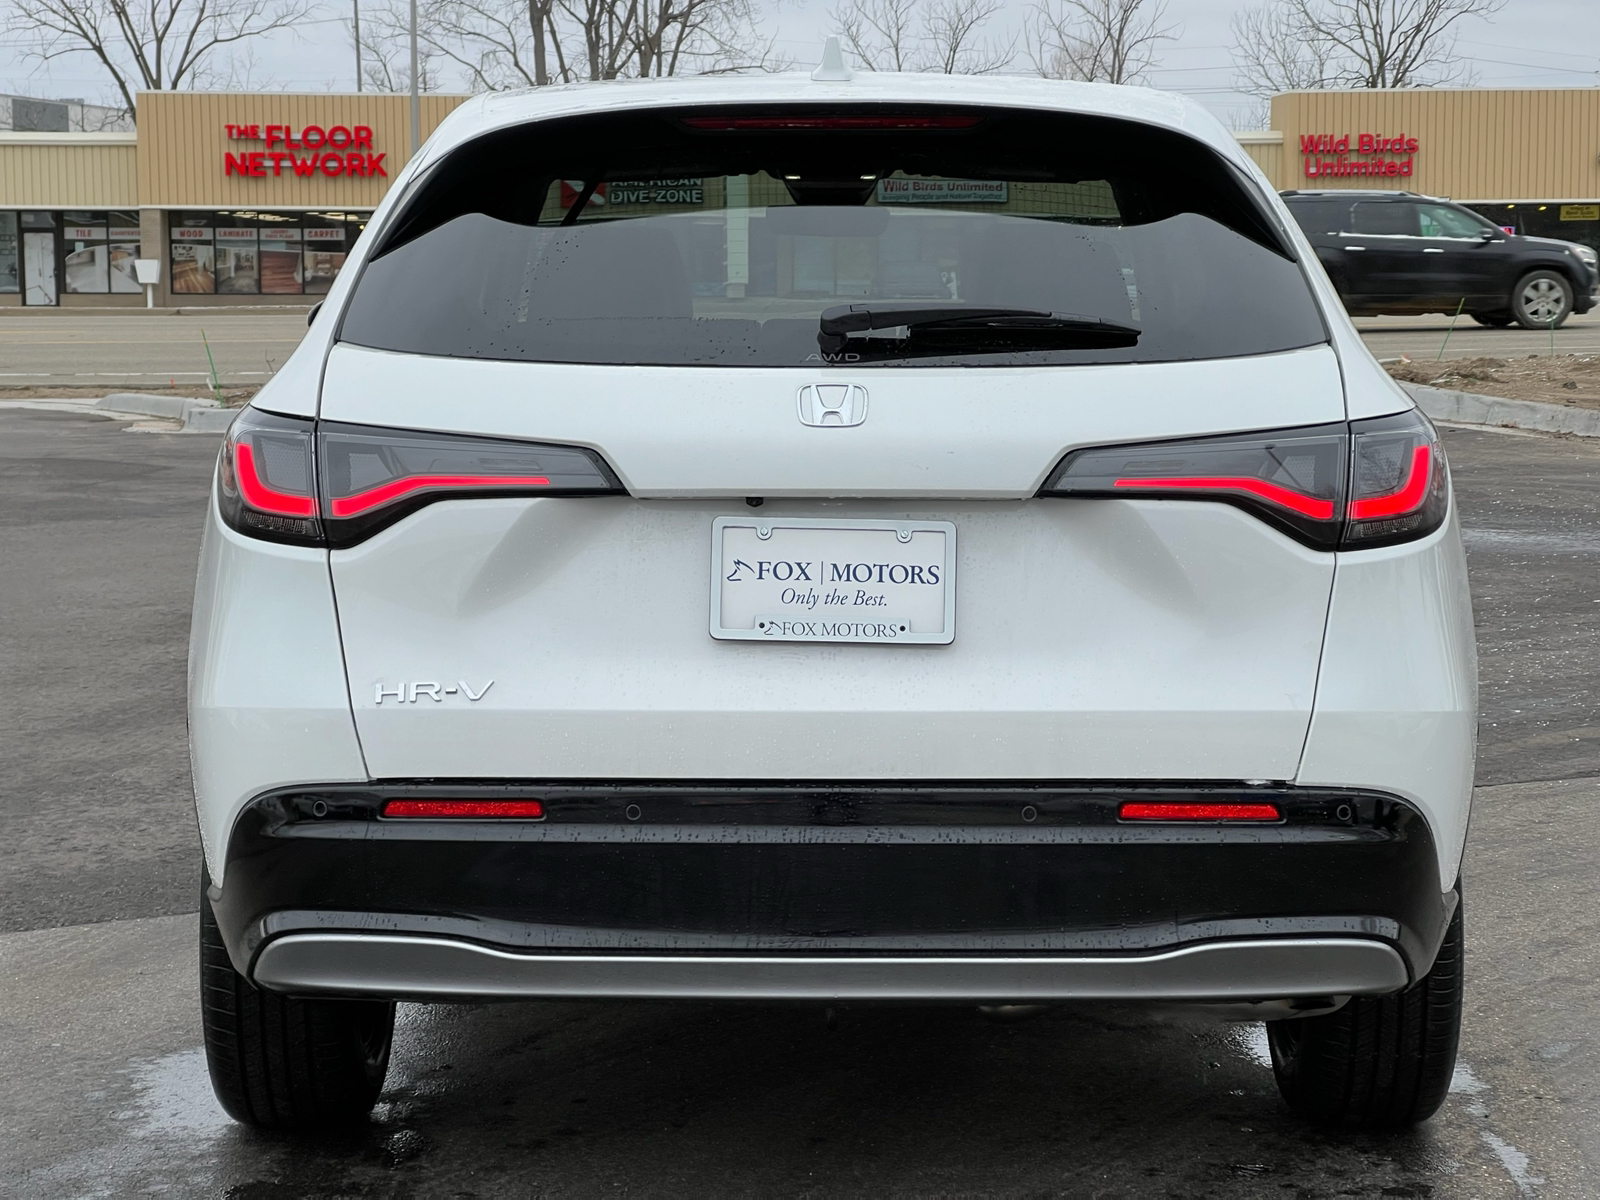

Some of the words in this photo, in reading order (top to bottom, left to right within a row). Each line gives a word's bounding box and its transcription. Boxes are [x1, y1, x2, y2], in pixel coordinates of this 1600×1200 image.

[225, 125, 259, 139] THE
[265, 125, 373, 150] FLOOR
[1300, 134, 1349, 155] Wild
[1358, 133, 1419, 155] Birds
[225, 152, 387, 177] NETWORK
[1305, 156, 1413, 178] Unlimited
[882, 180, 909, 192] Wild
[912, 181, 943, 192] Birds
[947, 182, 1003, 192] Unlimited
[611, 190, 650, 203] DIVE
[655, 190, 702, 203] ZONE
[76, 229, 92, 237] TILE
[218, 229, 253, 238] LAMINATE
[308, 230, 339, 238] CARPET
[805, 353, 860, 361] AWD
[756, 561, 813, 581] FOX
[830, 562, 940, 585] MOTORS
[780, 587, 819, 610] Only
[824, 588, 848, 606] the
[853, 589, 888, 607] Best.
[782, 621, 817, 636] FOX
[821, 622, 897, 638] MOTORS
[375, 680, 495, 704] HR-V
